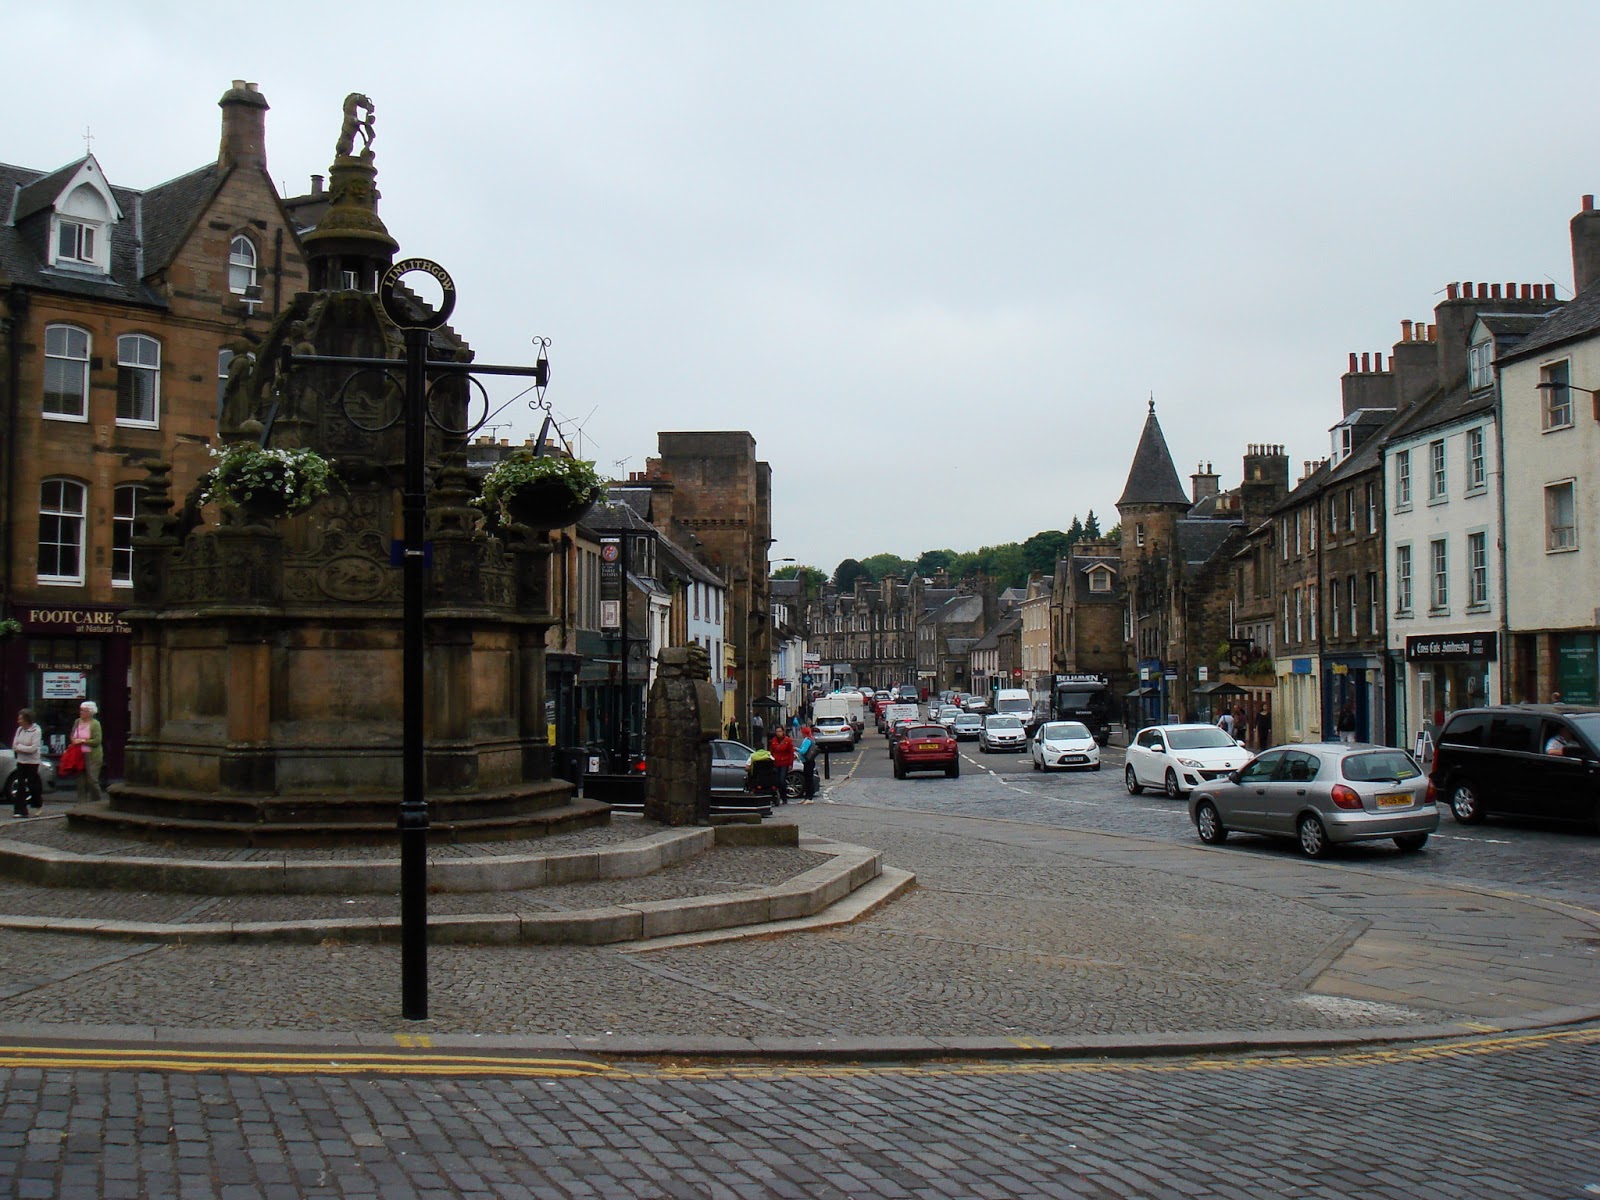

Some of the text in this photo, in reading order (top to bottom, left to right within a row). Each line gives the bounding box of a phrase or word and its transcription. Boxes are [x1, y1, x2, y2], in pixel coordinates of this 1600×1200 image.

[384, 260, 454, 291] LINLITHGOW
[30, 609, 114, 625] FOOTCARE
[1056, 674, 1099, 682] BELHAVEN
